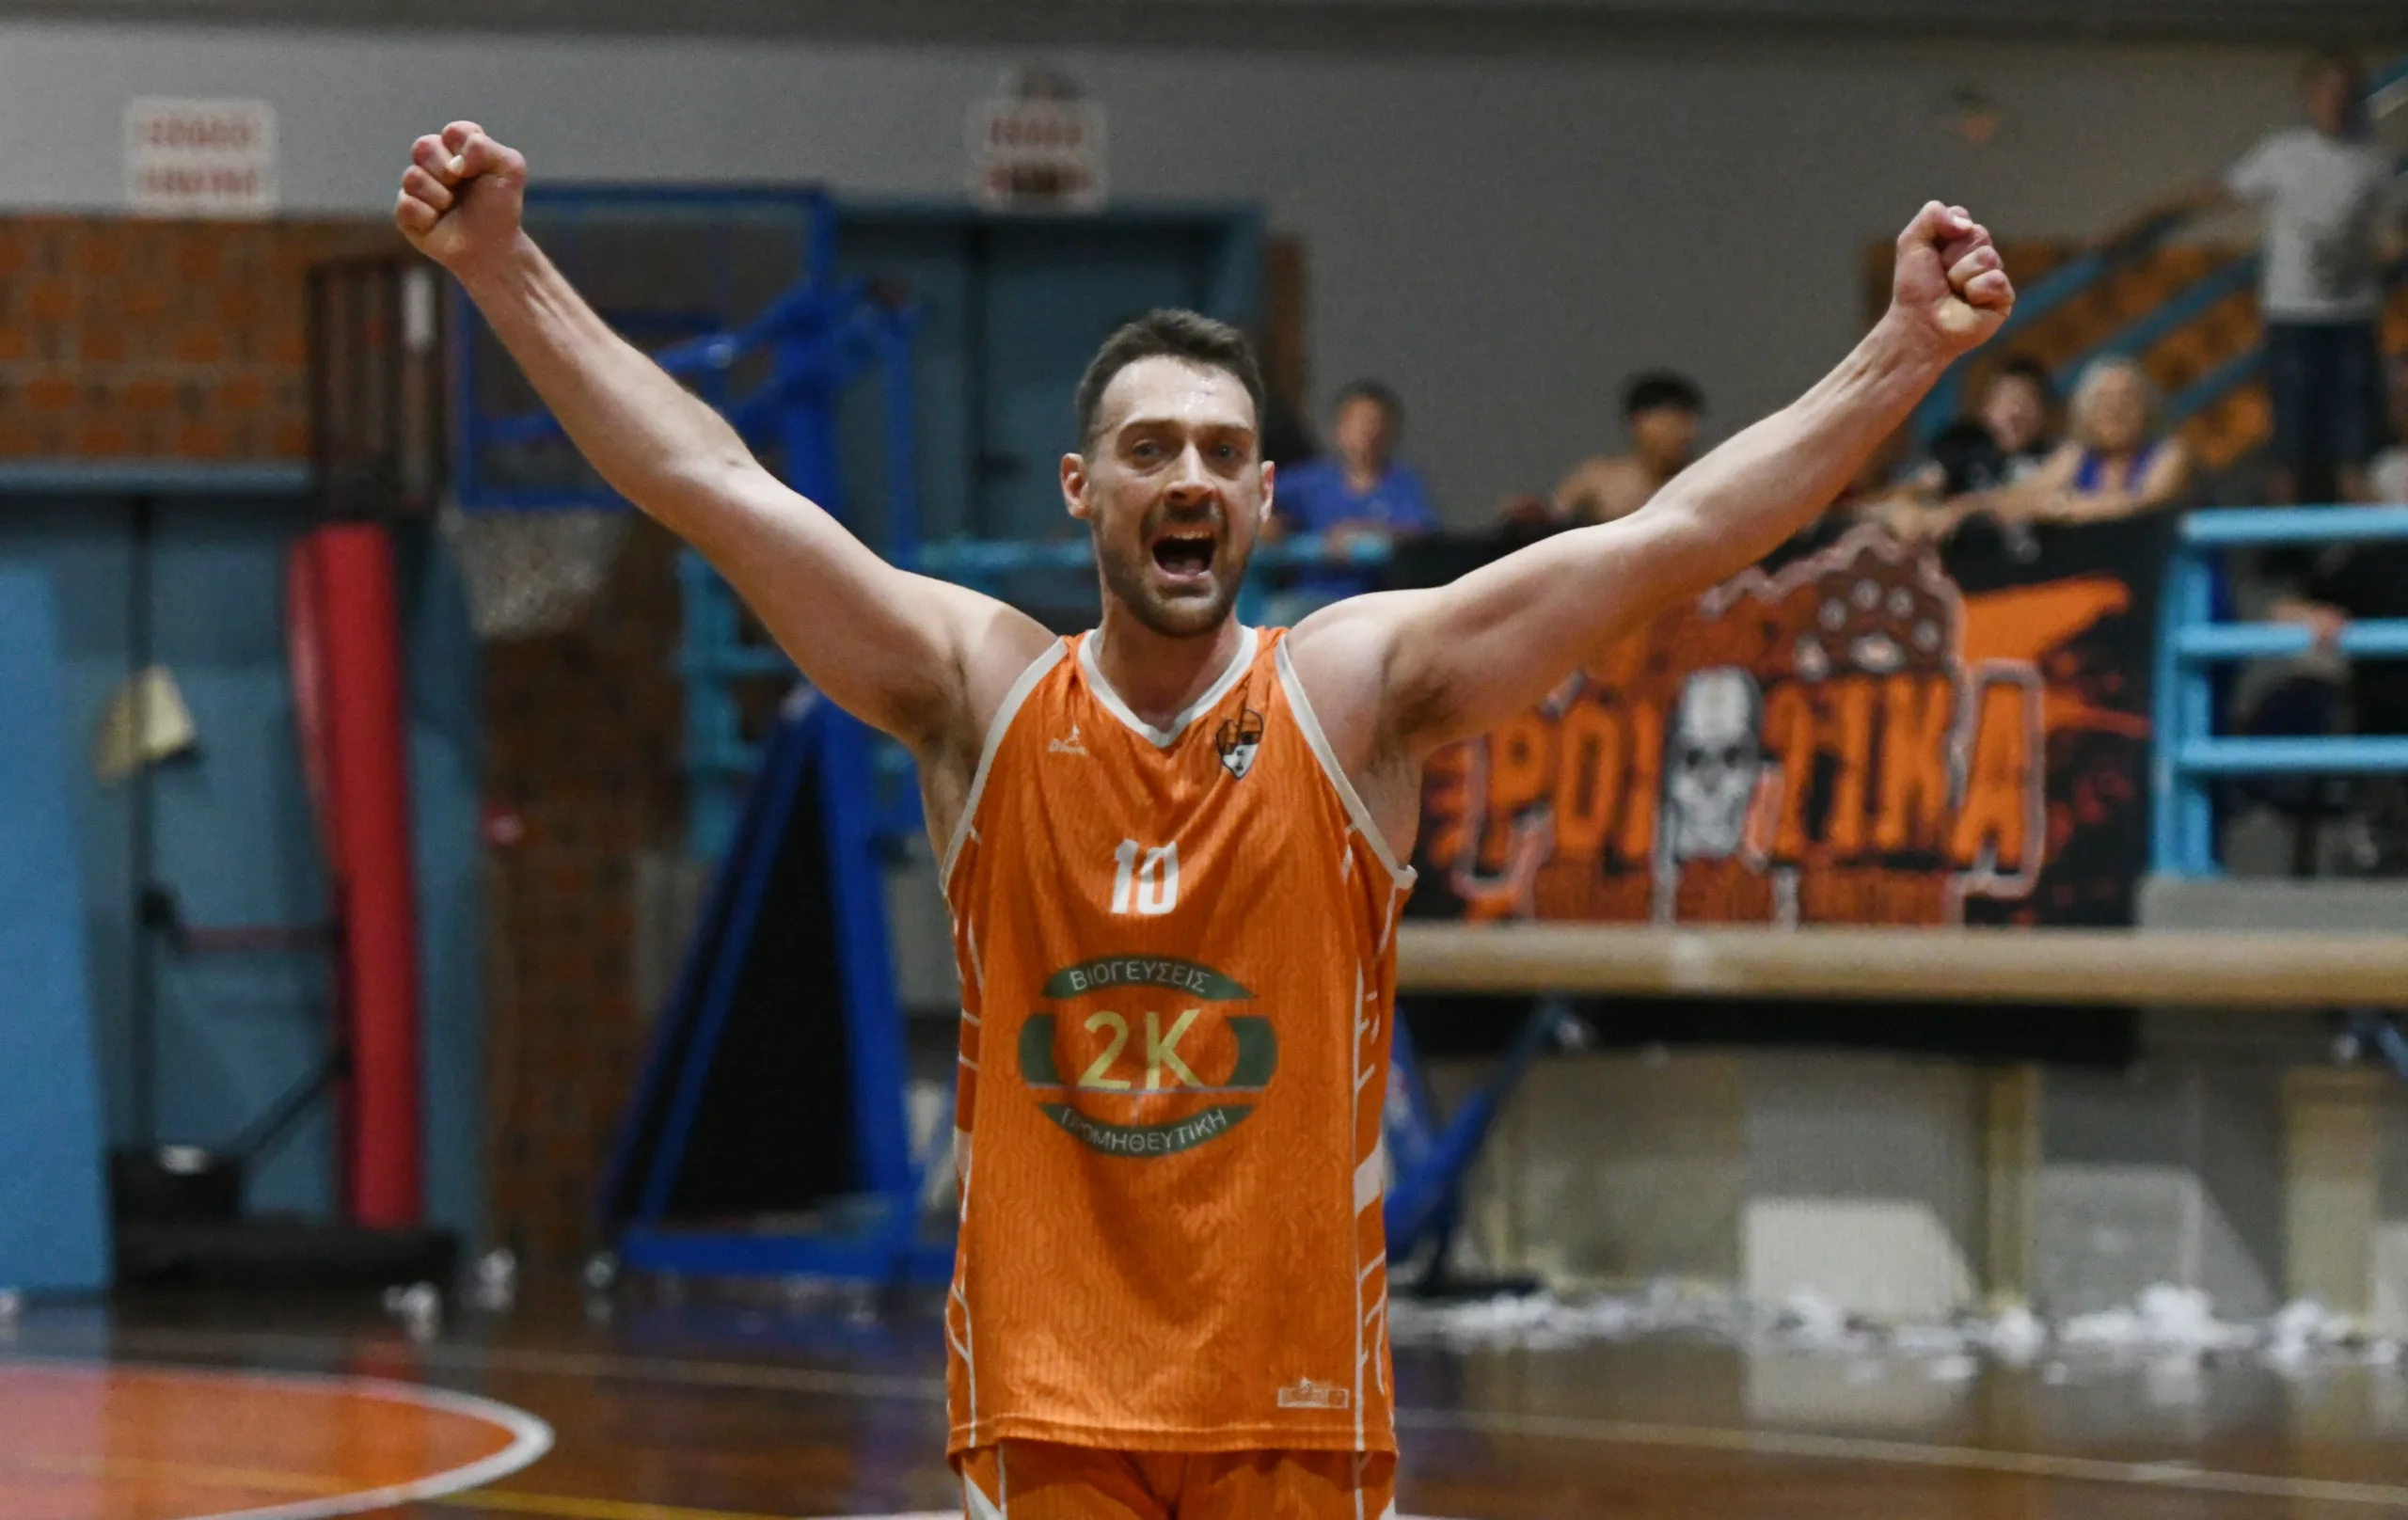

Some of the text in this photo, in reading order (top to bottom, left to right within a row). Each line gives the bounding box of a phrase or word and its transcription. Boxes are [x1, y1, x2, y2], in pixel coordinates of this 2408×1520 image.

[1111, 838, 1180, 914] 10
[1069, 959, 1212, 992] ΒΙΟΓΕΥΣΕΙΣ
[1076, 1007, 1206, 1091] 2K
